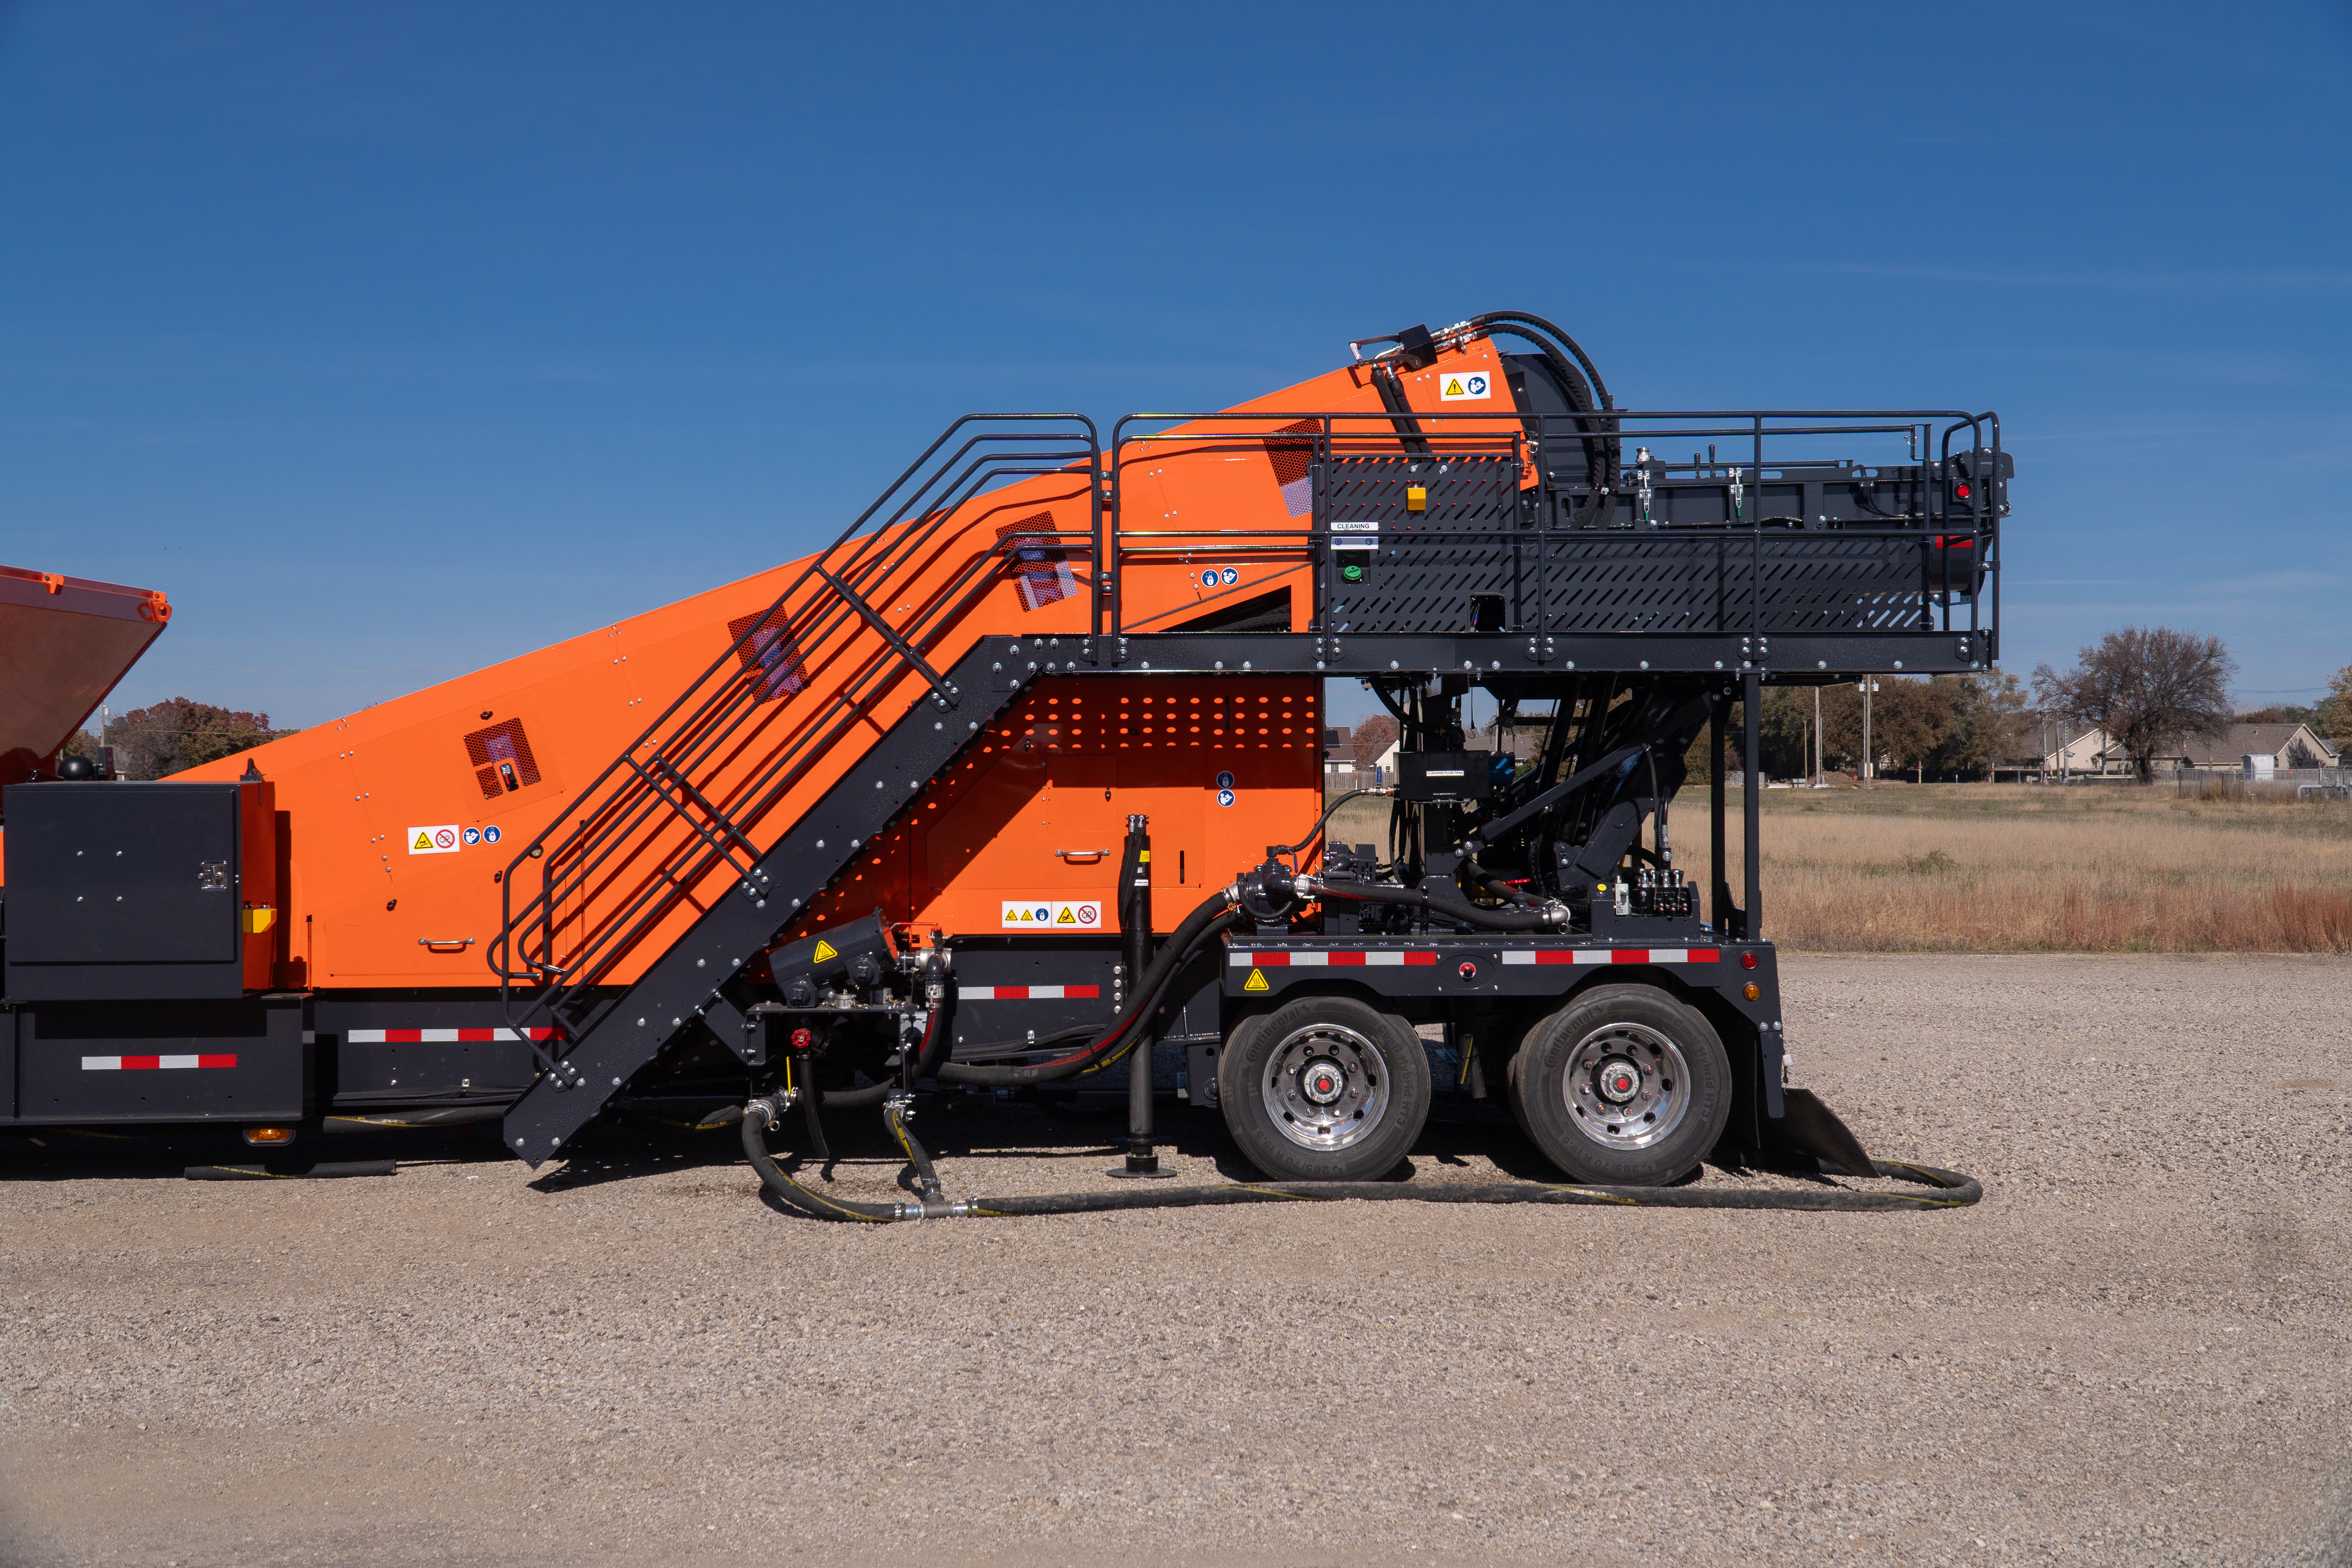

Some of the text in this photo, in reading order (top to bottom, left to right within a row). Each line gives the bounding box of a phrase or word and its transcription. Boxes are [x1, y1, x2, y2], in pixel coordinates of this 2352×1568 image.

[1246, 1006, 1299, 1063] Continental
[1544, 1008, 1594, 1068] Continental
[1398, 1055, 1413, 1097] Hybrid
[1396, 1101, 1411, 1125] HT3
[1702, 1093, 1714, 1118] HT3
